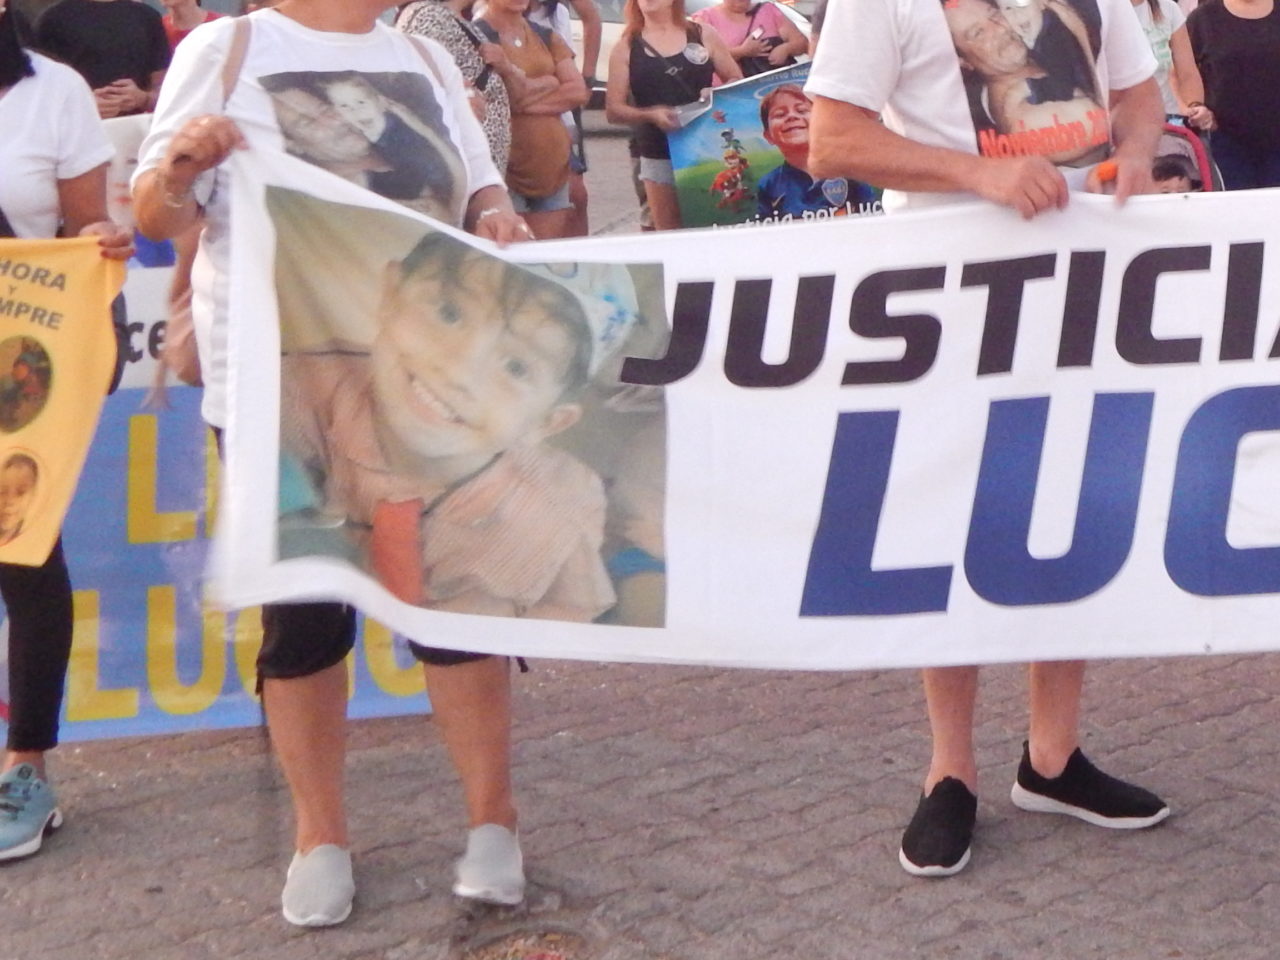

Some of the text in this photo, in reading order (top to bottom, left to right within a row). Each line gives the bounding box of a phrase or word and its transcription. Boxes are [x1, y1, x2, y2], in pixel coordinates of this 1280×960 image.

[846, 201, 882, 217] Luc
[0, 259, 67, 291] HORA
[0, 297, 64, 330] MPRE
